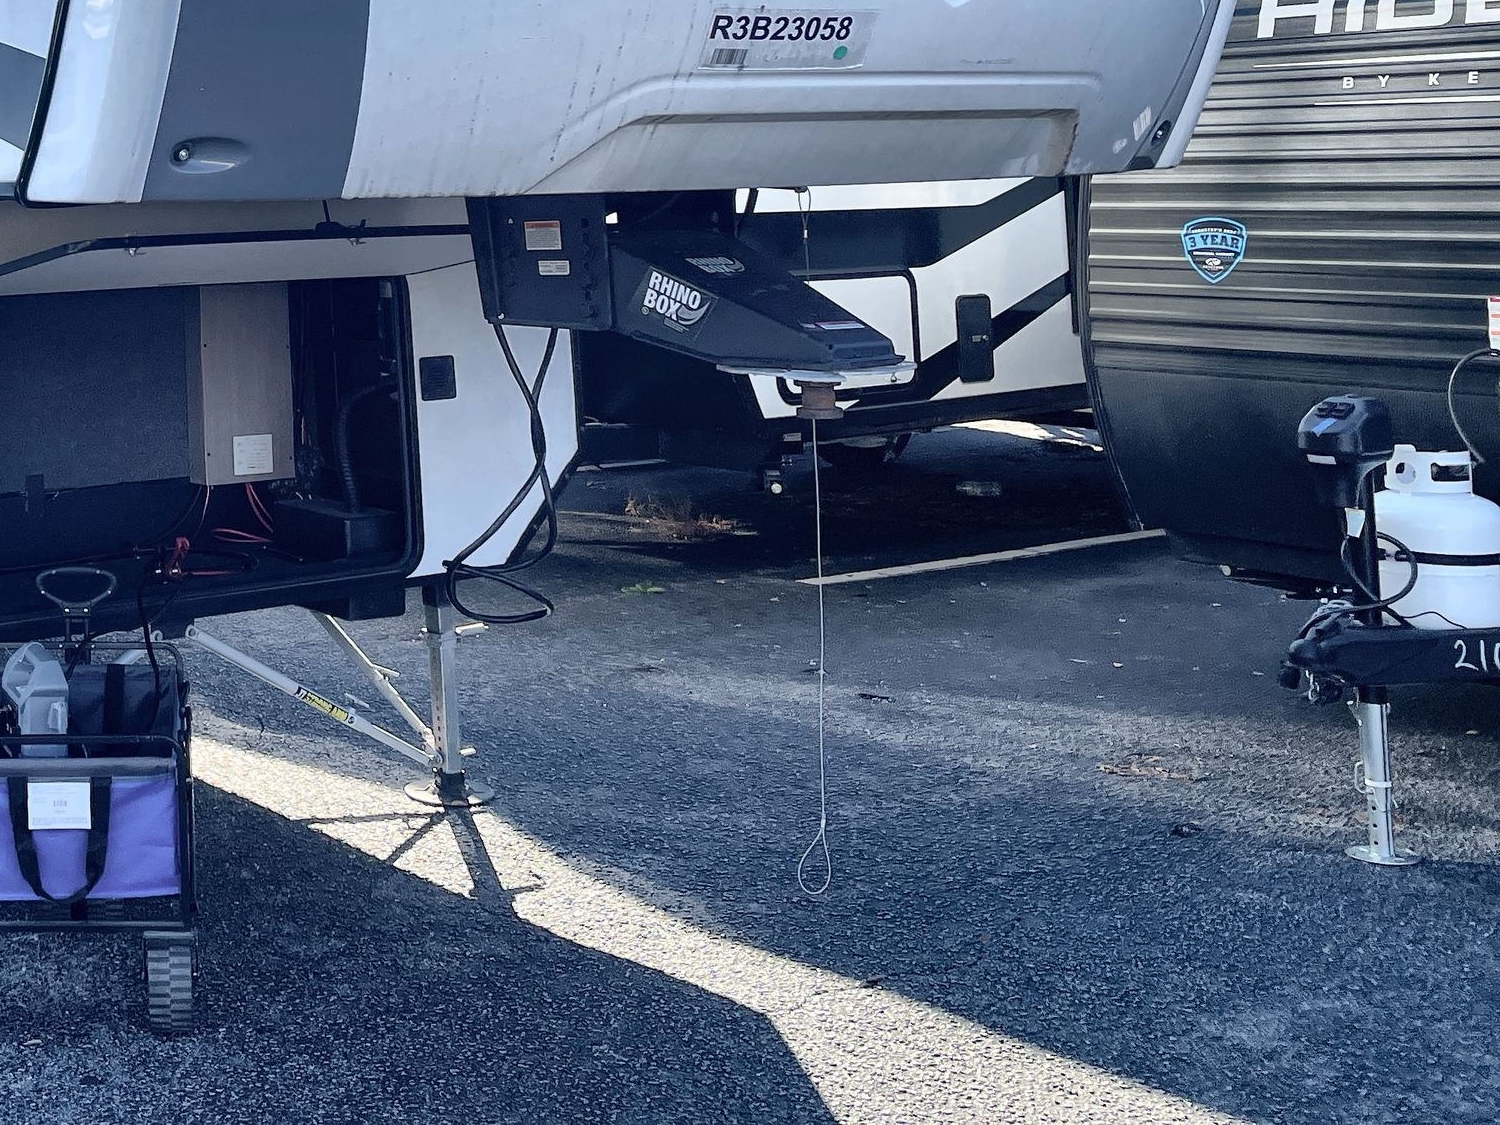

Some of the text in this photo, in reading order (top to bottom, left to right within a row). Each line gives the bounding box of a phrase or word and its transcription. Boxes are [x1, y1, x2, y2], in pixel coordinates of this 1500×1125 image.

[709, 15, 853, 41] R3B23058
[1342, 71, 1479, 89] BY KE
[1188, 235, 1240, 249] 3 YEAR
[649, 271, 702, 310] RHINO
[643, 288, 681, 321] BOX
